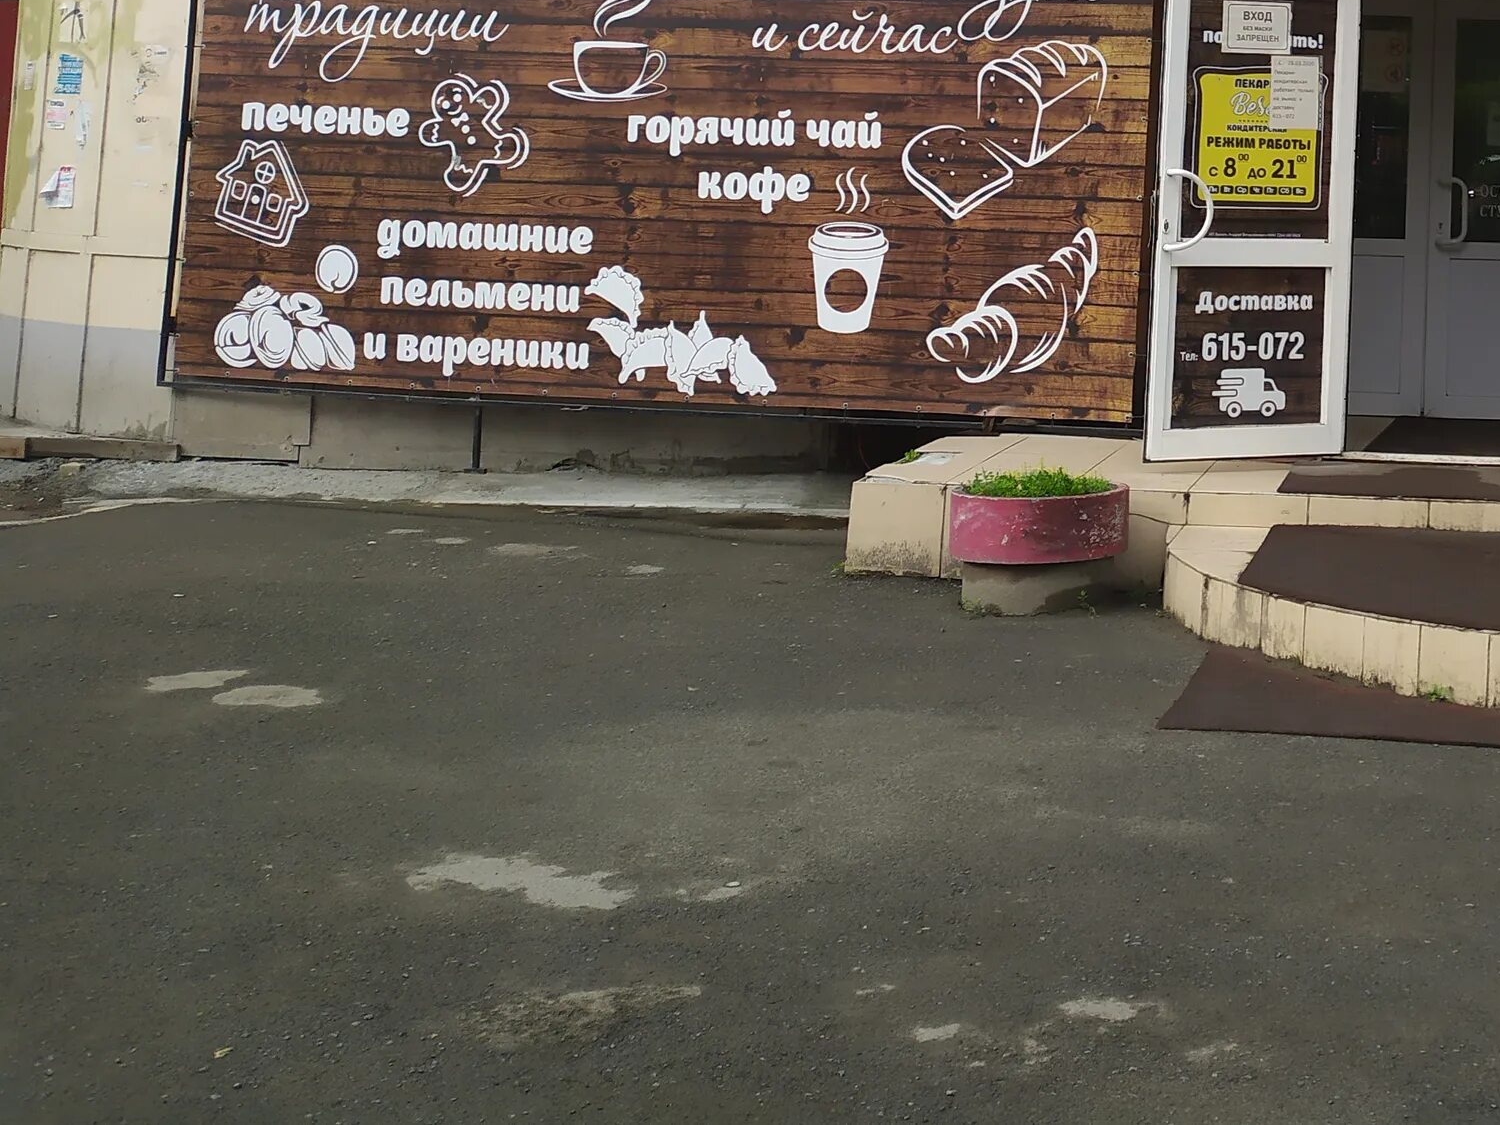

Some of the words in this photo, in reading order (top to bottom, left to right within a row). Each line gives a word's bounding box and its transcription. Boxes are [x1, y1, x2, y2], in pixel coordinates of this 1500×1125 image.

[751, 19, 790, 53] и
[799, 9, 958, 54] сейчас
[1243, 11, 1273, 23] ВХОД
[1235, 79, 1271, 88] ПЕКАР
[242, 100, 410, 139] печенье
[627, 109, 796, 156] горячий
[806, 110, 882, 149] чай
[1207, 136, 1256, 149] РЕЖИМ
[1258, 138, 1311, 151] РАБОТЫ
[697, 166, 811, 214] кофе
[376, 216, 594, 259] домашние
[380, 276, 581, 313] пельмени
[1195, 291, 1313, 314] Доставка
[363, 339, 387, 362] и
[397, 337, 590, 377] вареники
[1180, 352, 1199, 362] Тел:
[1201, 331, 1305, 361] 615-072
